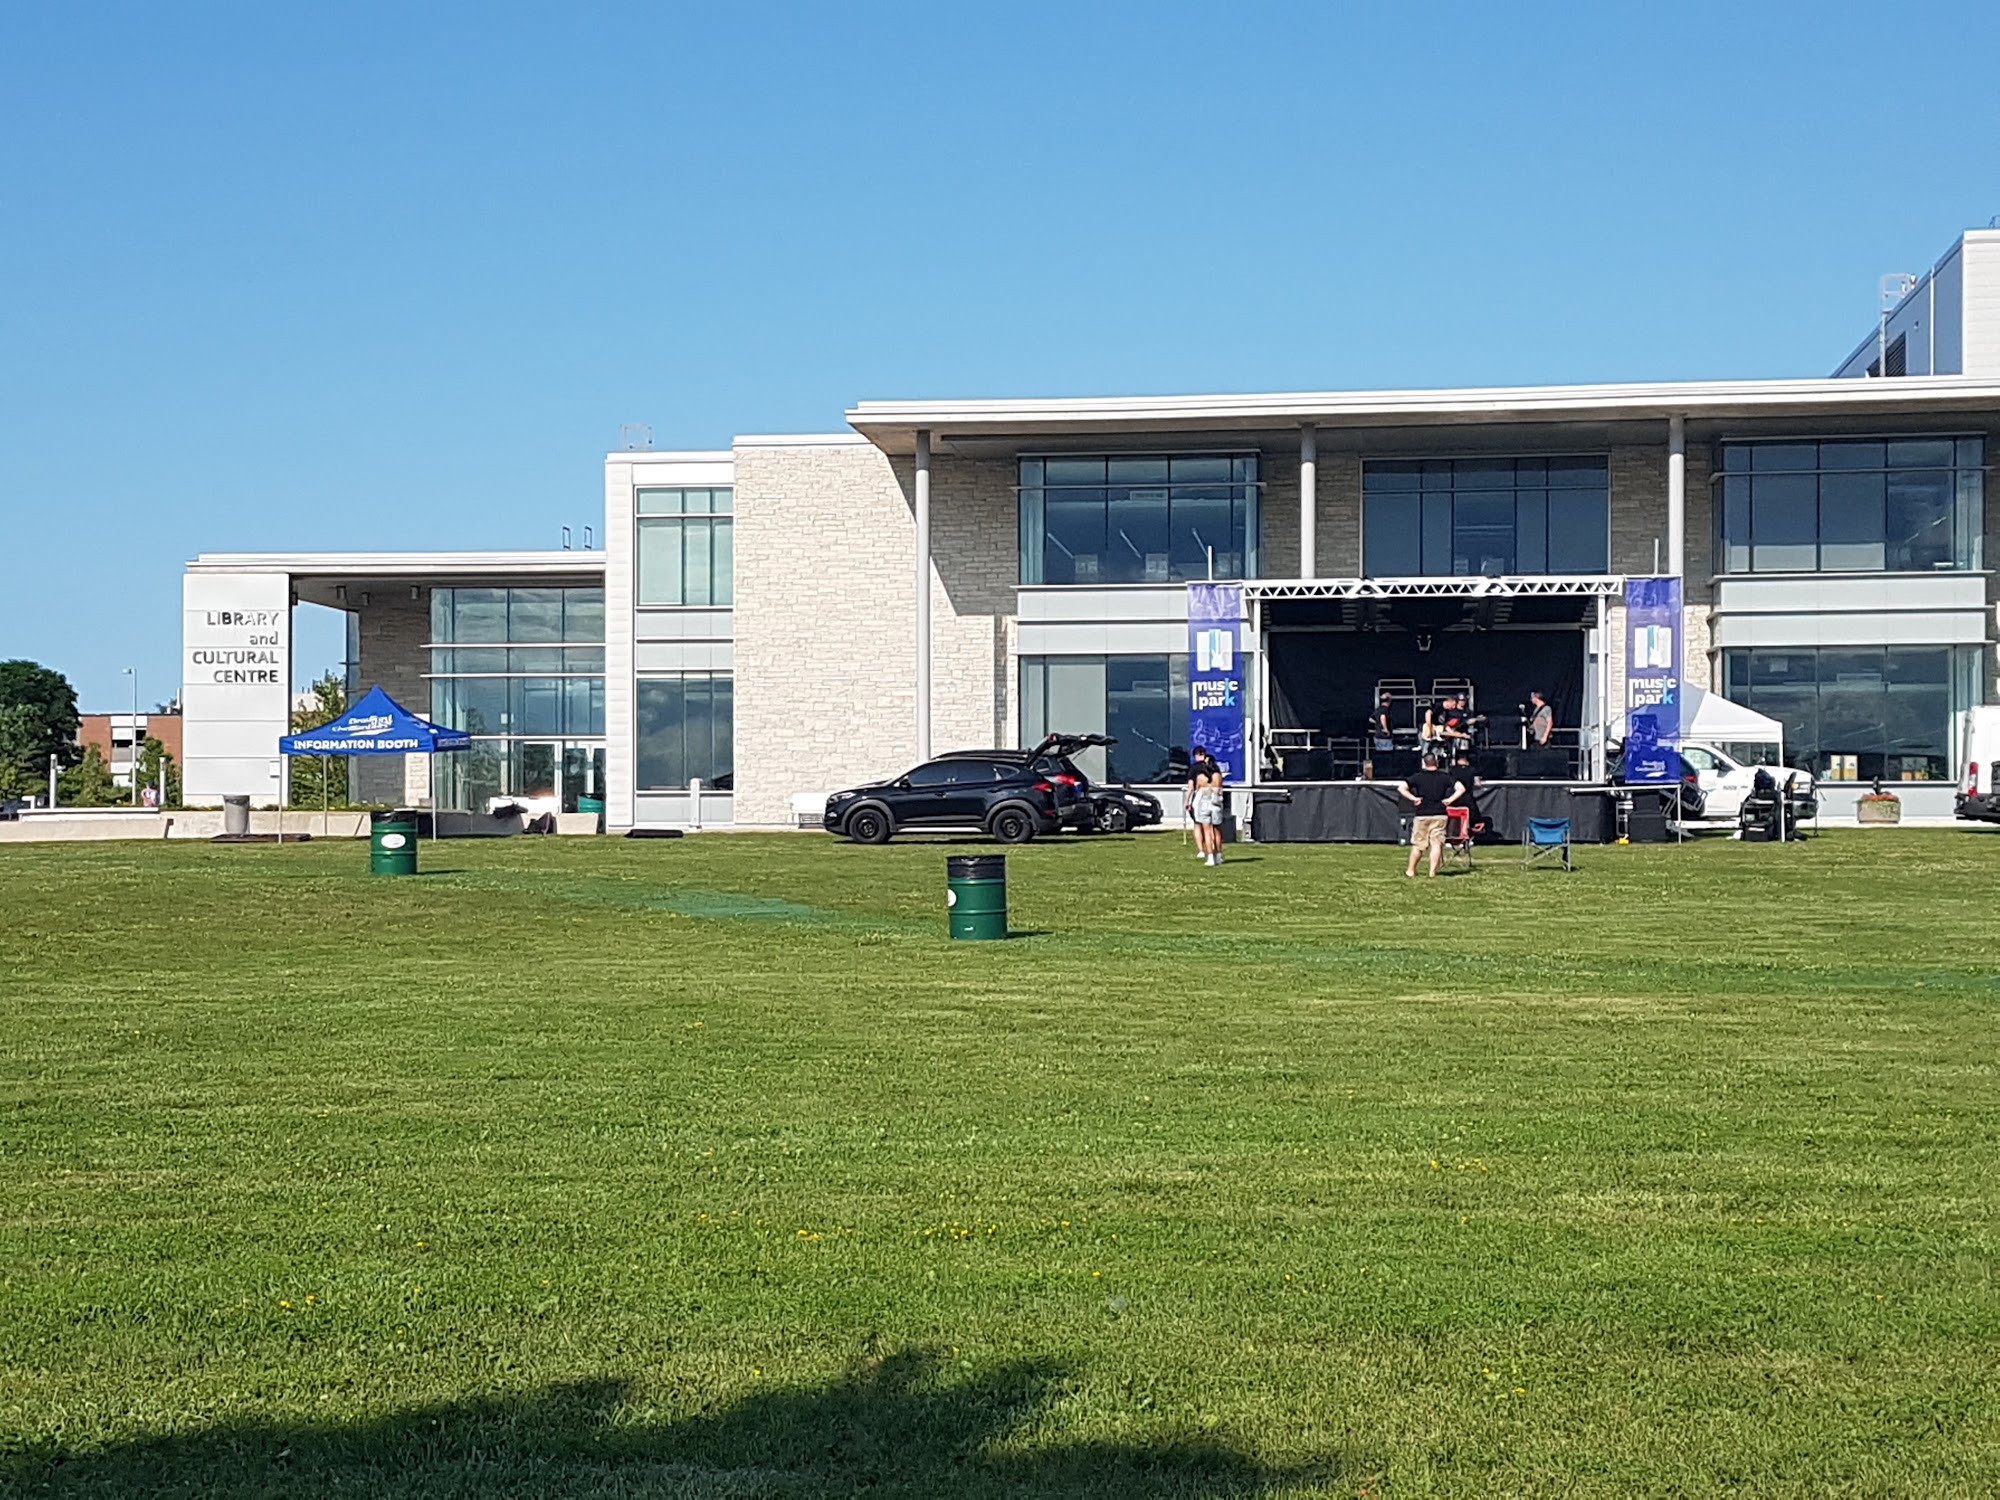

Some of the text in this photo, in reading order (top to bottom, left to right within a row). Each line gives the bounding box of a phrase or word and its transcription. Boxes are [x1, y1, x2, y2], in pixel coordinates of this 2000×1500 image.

[207, 611, 279, 626] LIBRARY
[249, 631, 279, 646] and
[192, 651, 279, 664] CULTURAL
[213, 669, 279, 683] CENTRE
[1629, 676, 1677, 689] music
[1192, 678, 1239, 691] music
[1198, 696, 1236, 710] park
[1634, 694, 1674, 708] park
[293, 739, 418, 750] INFORMATION BOOTH
